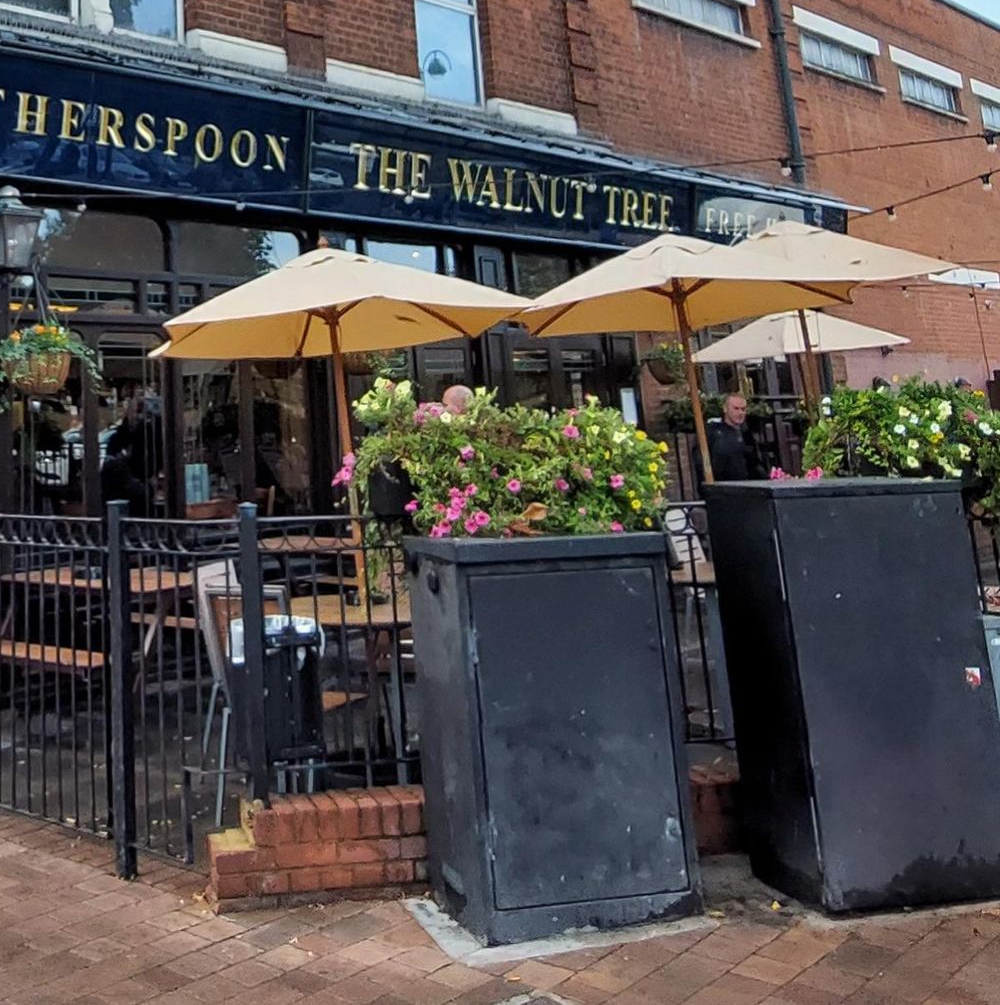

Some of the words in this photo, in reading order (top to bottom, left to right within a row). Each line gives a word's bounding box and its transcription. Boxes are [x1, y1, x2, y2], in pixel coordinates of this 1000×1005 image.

[350, 143, 432, 200] THE
[446, 157, 587, 221] WALNUT
[603, 184, 677, 232] TREE
[704, 207, 757, 238] FREE
